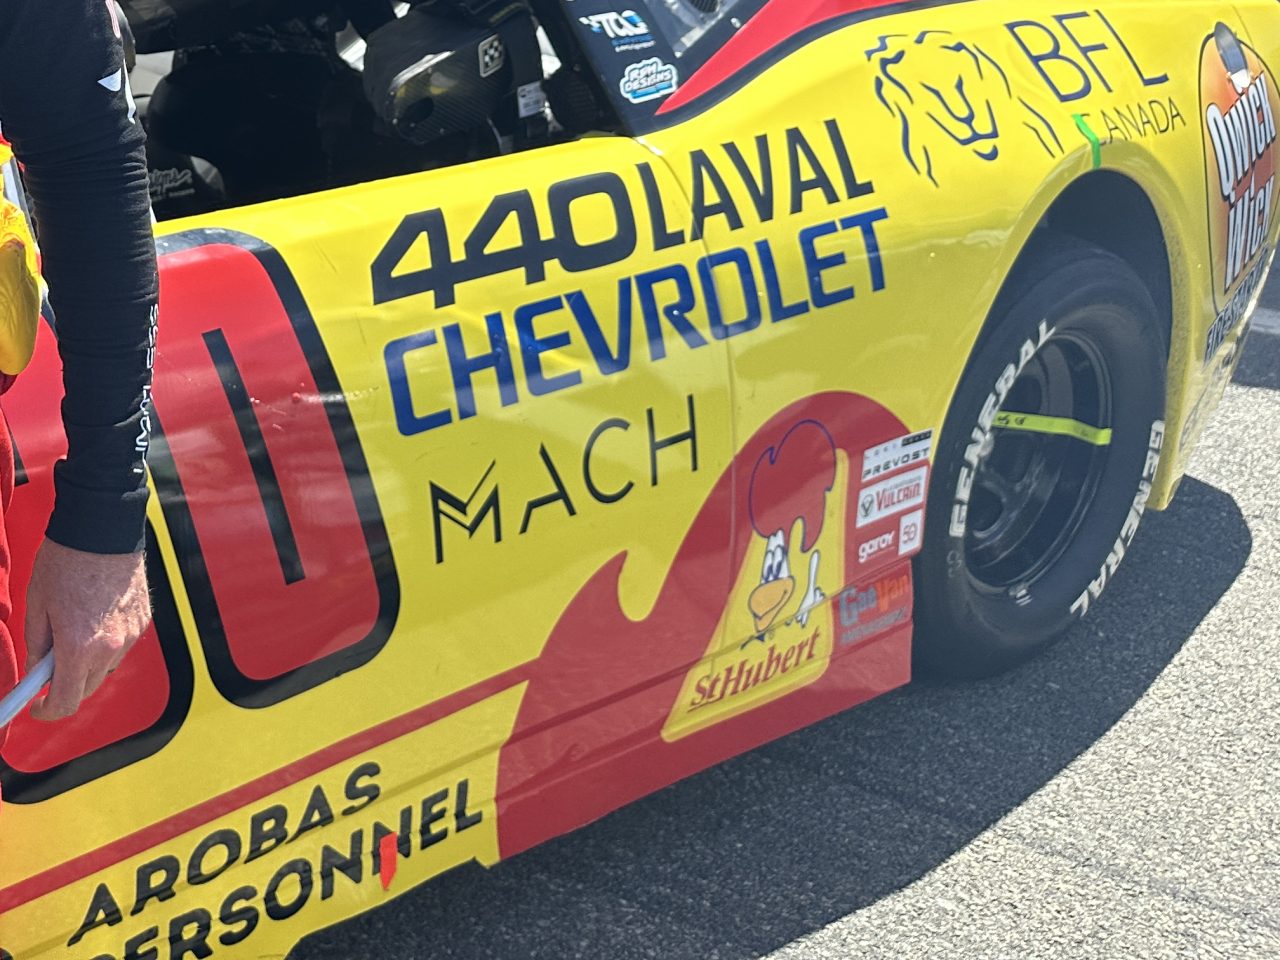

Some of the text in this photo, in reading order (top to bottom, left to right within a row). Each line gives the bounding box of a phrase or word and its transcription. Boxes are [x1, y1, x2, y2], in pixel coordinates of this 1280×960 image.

[1005, 8, 1169, 104] BFL
[372, 119, 875, 310] 440 LAVAL
[384, 208, 888, 437] CHEVROLET
[431, 395, 699, 564] MACH
[862, 447, 931, 480] PREVOST
[948, 318, 1057, 538] GENERAL
[1070, 419, 1166, 618] GENERAL
[67, 761, 382, 948] AROBAS
[88, 778, 483, 960] ERSONNEL
